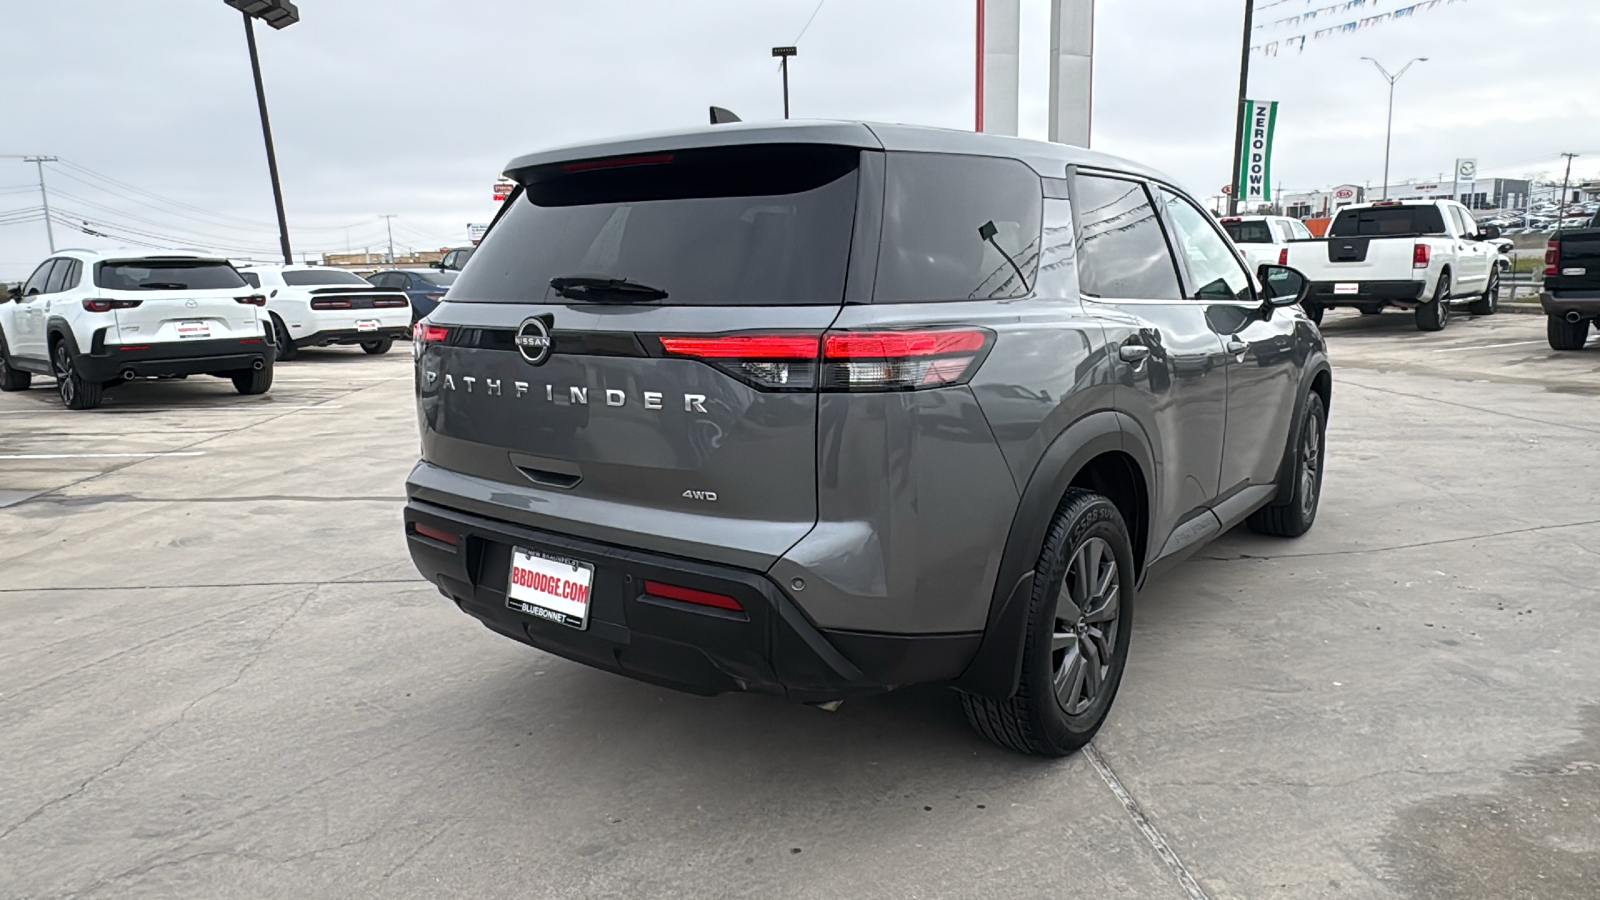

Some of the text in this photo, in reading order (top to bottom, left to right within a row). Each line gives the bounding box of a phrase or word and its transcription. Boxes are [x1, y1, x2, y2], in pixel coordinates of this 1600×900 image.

[1249, 106, 1267, 195] ZERO DOWN
[514, 337, 550, 346] NISSAN
[425, 370, 708, 413] PATHFINDER
[682, 489, 718, 501] 4WD
[512, 566, 589, 604] BBDODGE.COM
[521, 603, 567, 622] BLUEBONNET
